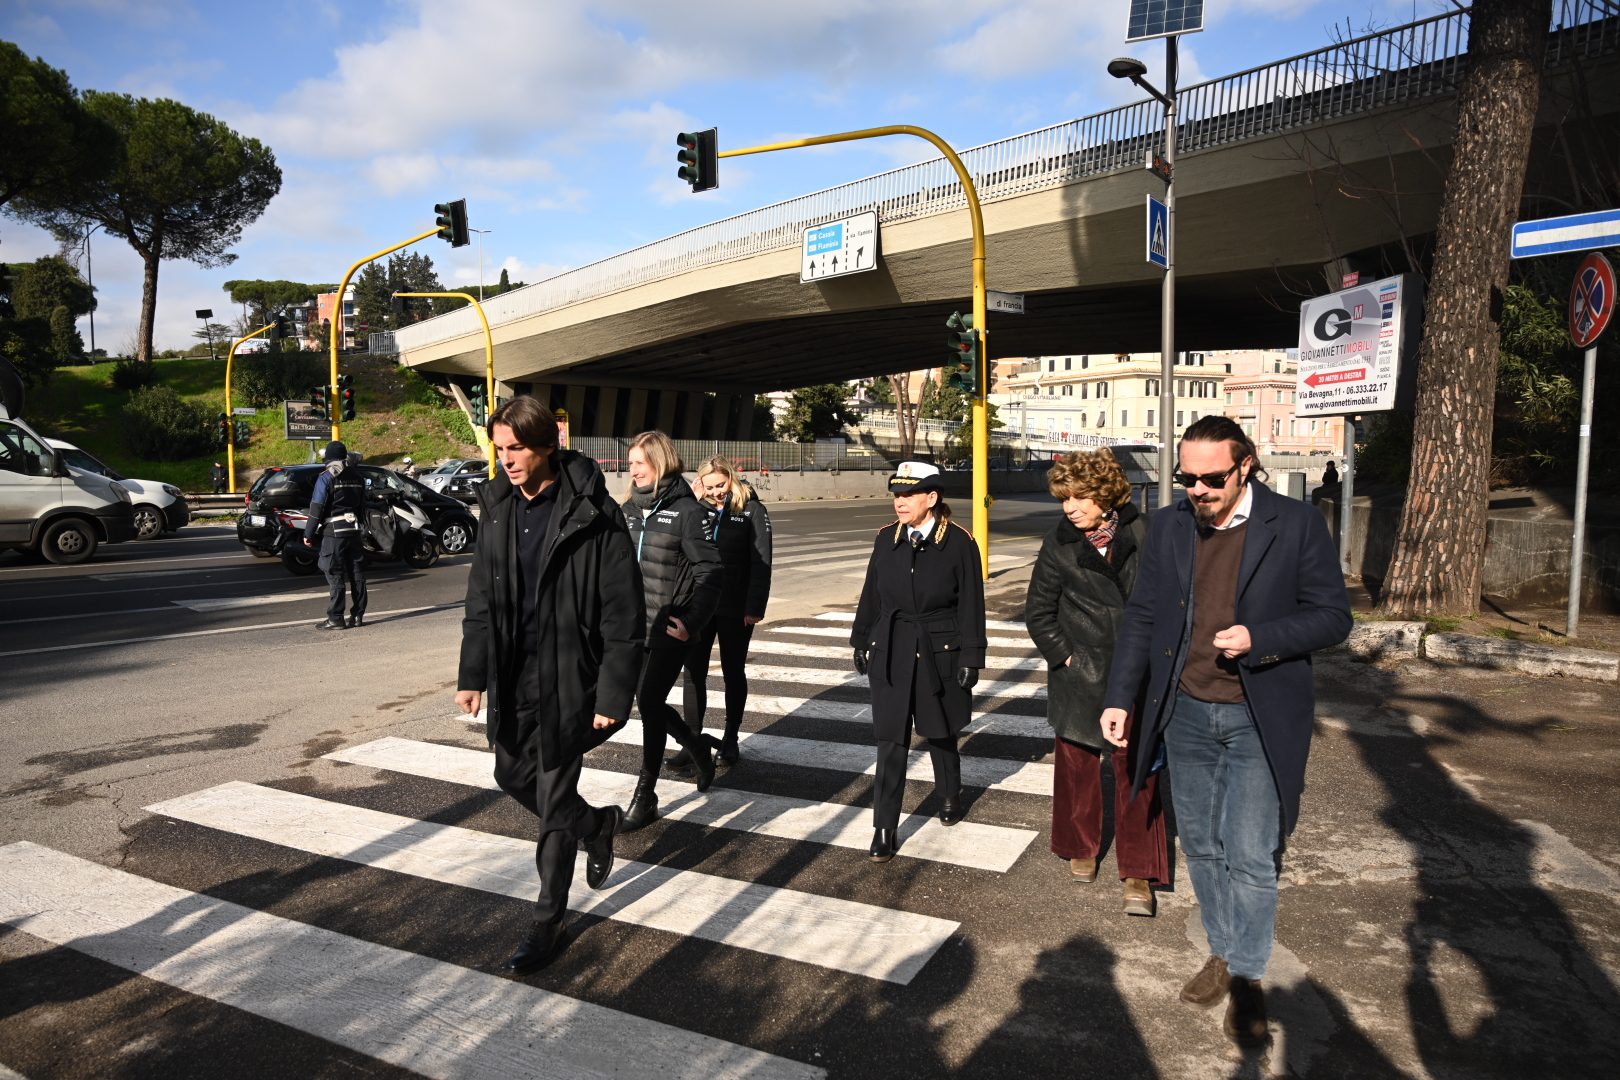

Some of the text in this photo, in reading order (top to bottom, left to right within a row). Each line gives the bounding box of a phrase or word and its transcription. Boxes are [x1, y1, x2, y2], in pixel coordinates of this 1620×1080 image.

[1325, 374, 1339, 382] METRI
[1344, 371, 1362, 380] DESTRA
[1299, 391, 1308, 399] Via
[1346, 383, 1387, 395] 06.333.22.17
[1305, 396, 1378, 410] www.giovannettimobili.it
